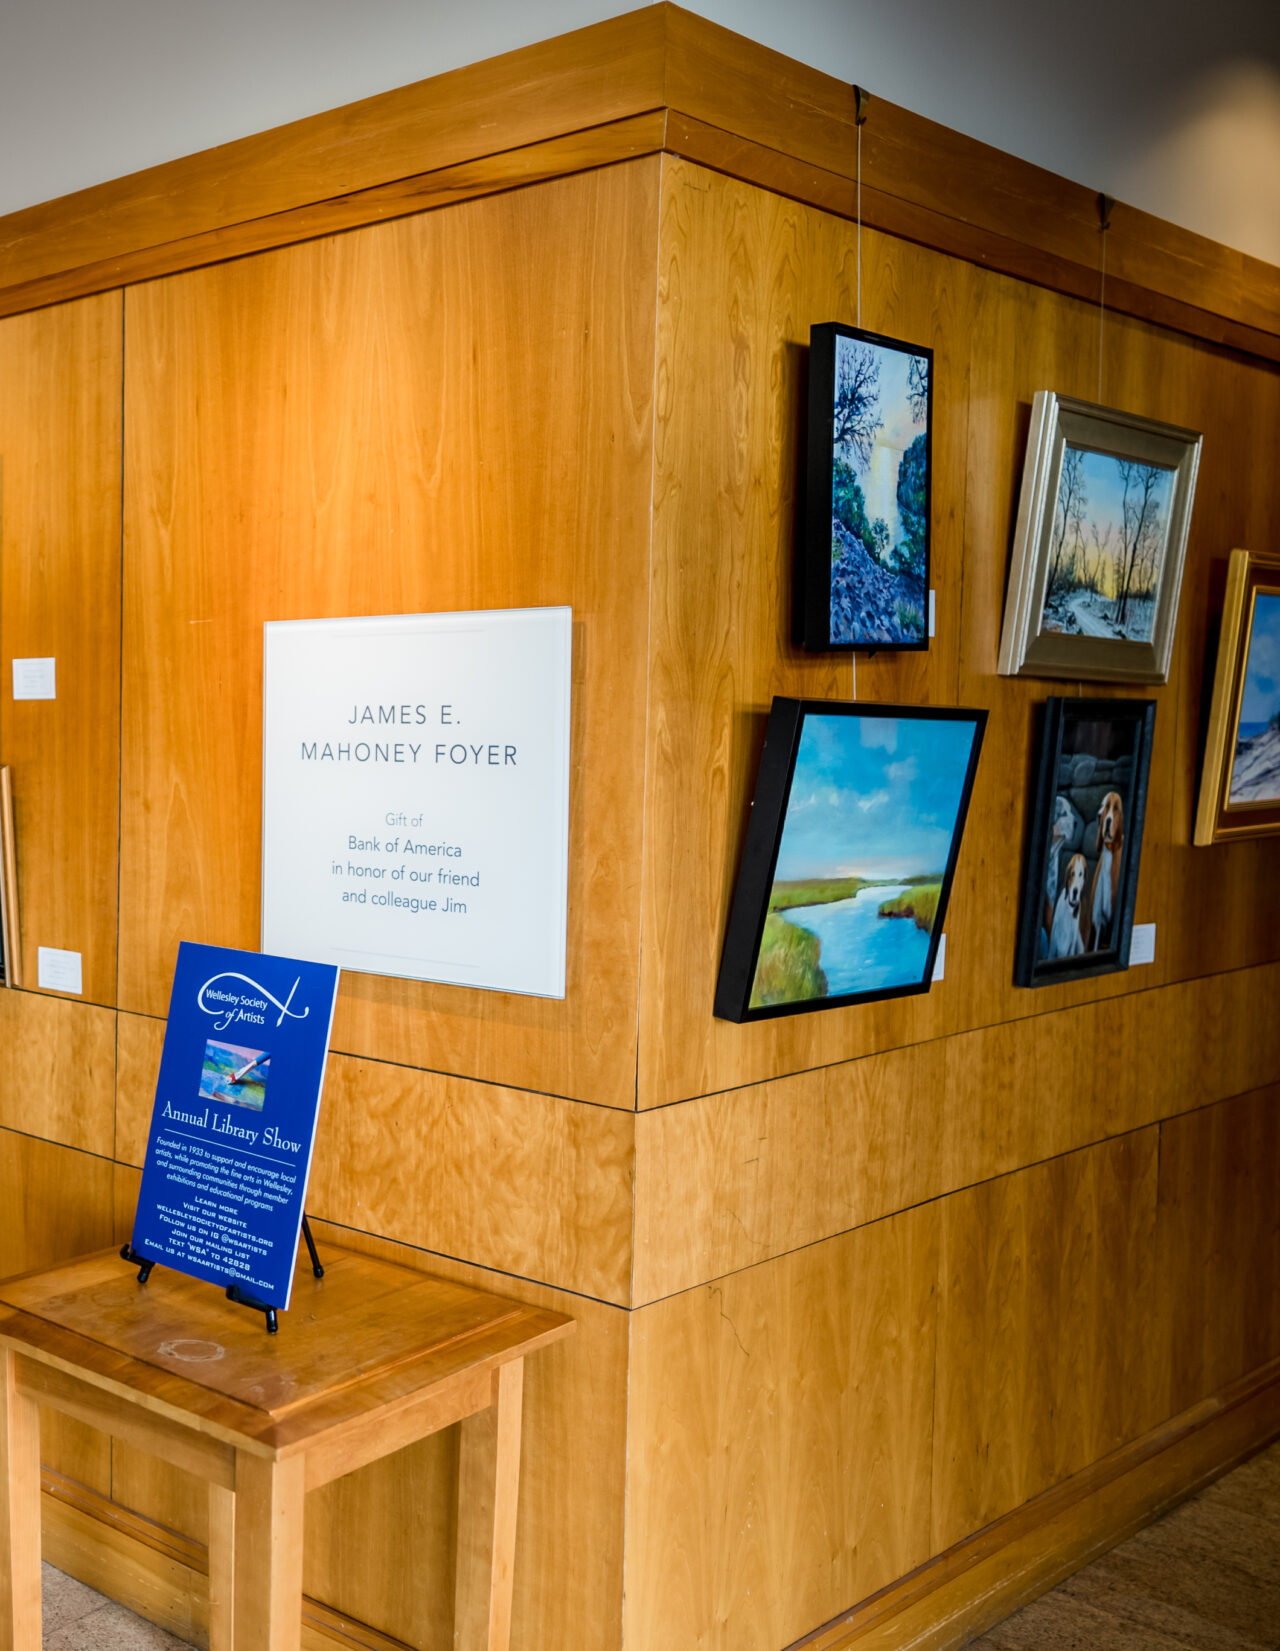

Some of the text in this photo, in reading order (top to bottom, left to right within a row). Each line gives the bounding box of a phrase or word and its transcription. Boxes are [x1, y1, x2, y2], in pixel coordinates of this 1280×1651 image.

[348, 704, 461, 725] JAMES E.
[301, 742, 518, 766] MAHONEY FOYER
[385, 812, 424, 827] Gift of
[348, 835, 462, 858] Bank of America
[331, 860, 480, 887] in honor of our friend
[342, 888, 467, 914] and colleague Jim
[206, 988, 268, 1011] Wellesley Society
[213, 1008, 265, 1031] of Artists
[161, 1100, 302, 1153] Annual Library Show
[156, 1136, 297, 1184] Founded in 1933 to support and encourage local
[156, 1159, 289, 1204] and surrounding communities through member
[174, 1153, 189, 1164] while
[189, 1158, 219, 1174] promoting
[220, 1165, 230, 1175] the
[230, 1168, 242, 1179] fine
[242, 1173, 255, 1183] arts
[263, 1178, 293, 1195] Wellesley,
[166, 1172, 274, 1212] exhibitions and educational programs
